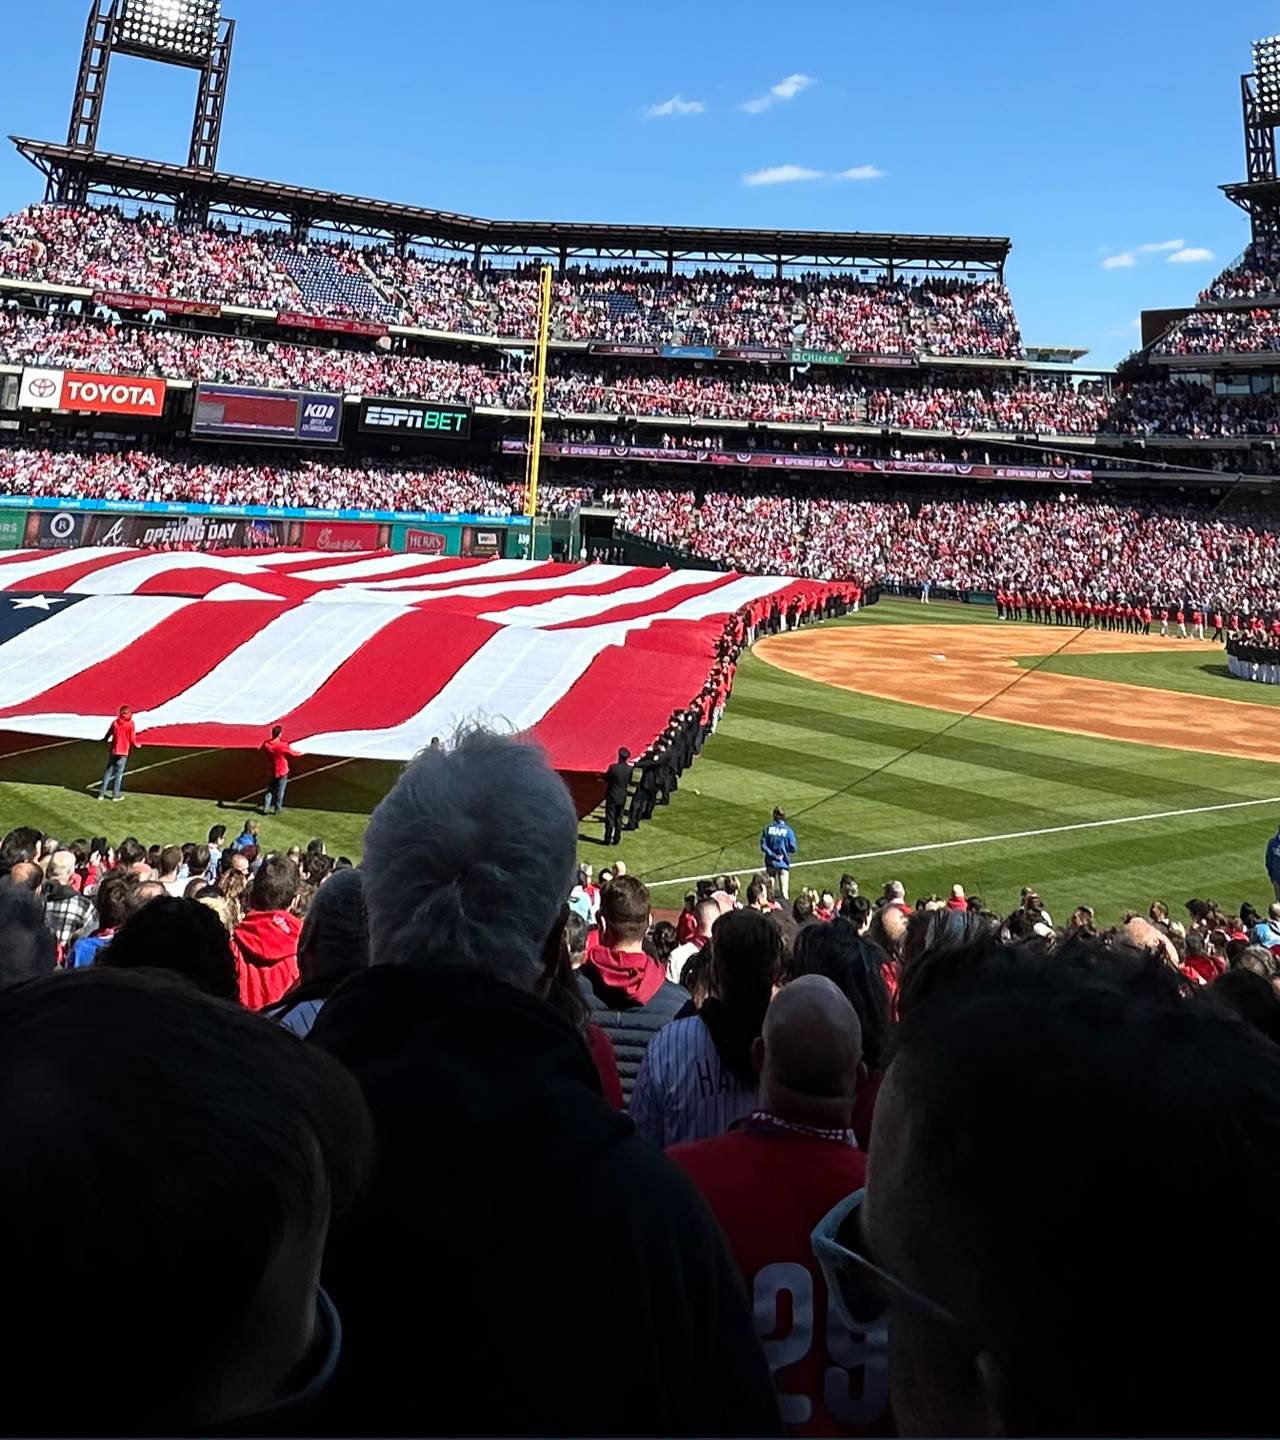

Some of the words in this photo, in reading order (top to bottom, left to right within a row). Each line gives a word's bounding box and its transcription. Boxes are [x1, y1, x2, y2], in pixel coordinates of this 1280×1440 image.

[802, 352, 839, 363] Citizens
[67, 381, 156, 406] TOYOTA
[304, 403, 336, 419] KDI
[143, 526, 205, 543] OPENING
[208, 523, 237, 540] DAY
